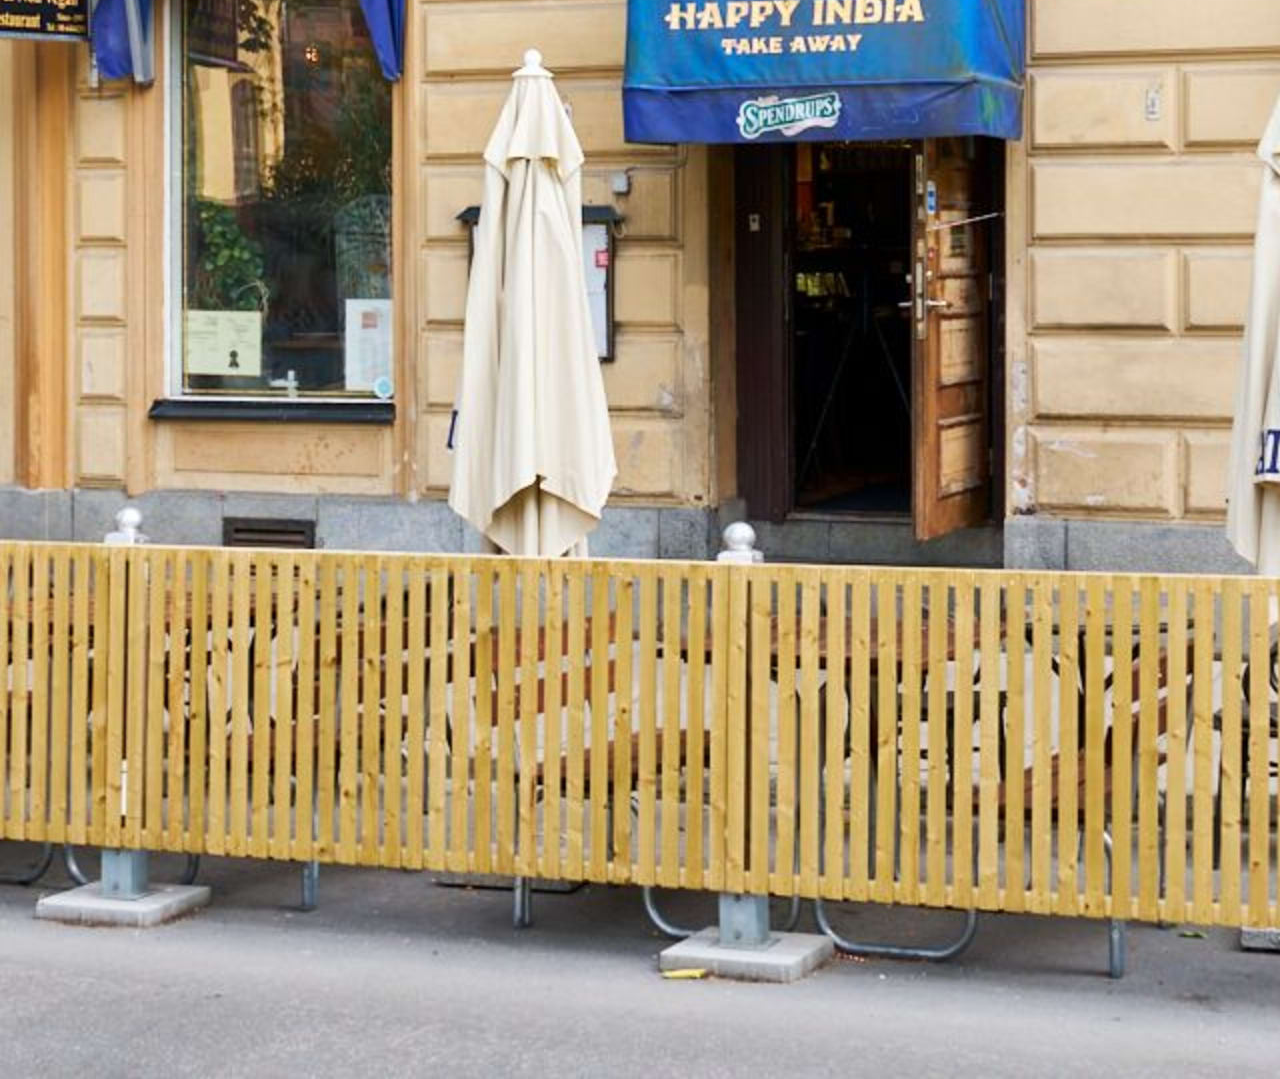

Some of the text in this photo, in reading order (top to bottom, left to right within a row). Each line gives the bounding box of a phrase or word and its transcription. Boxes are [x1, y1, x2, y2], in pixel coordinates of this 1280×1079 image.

[721, 34, 862, 56] TAKE AWAY
[744, 97, 834, 133] SPENDRUPS
